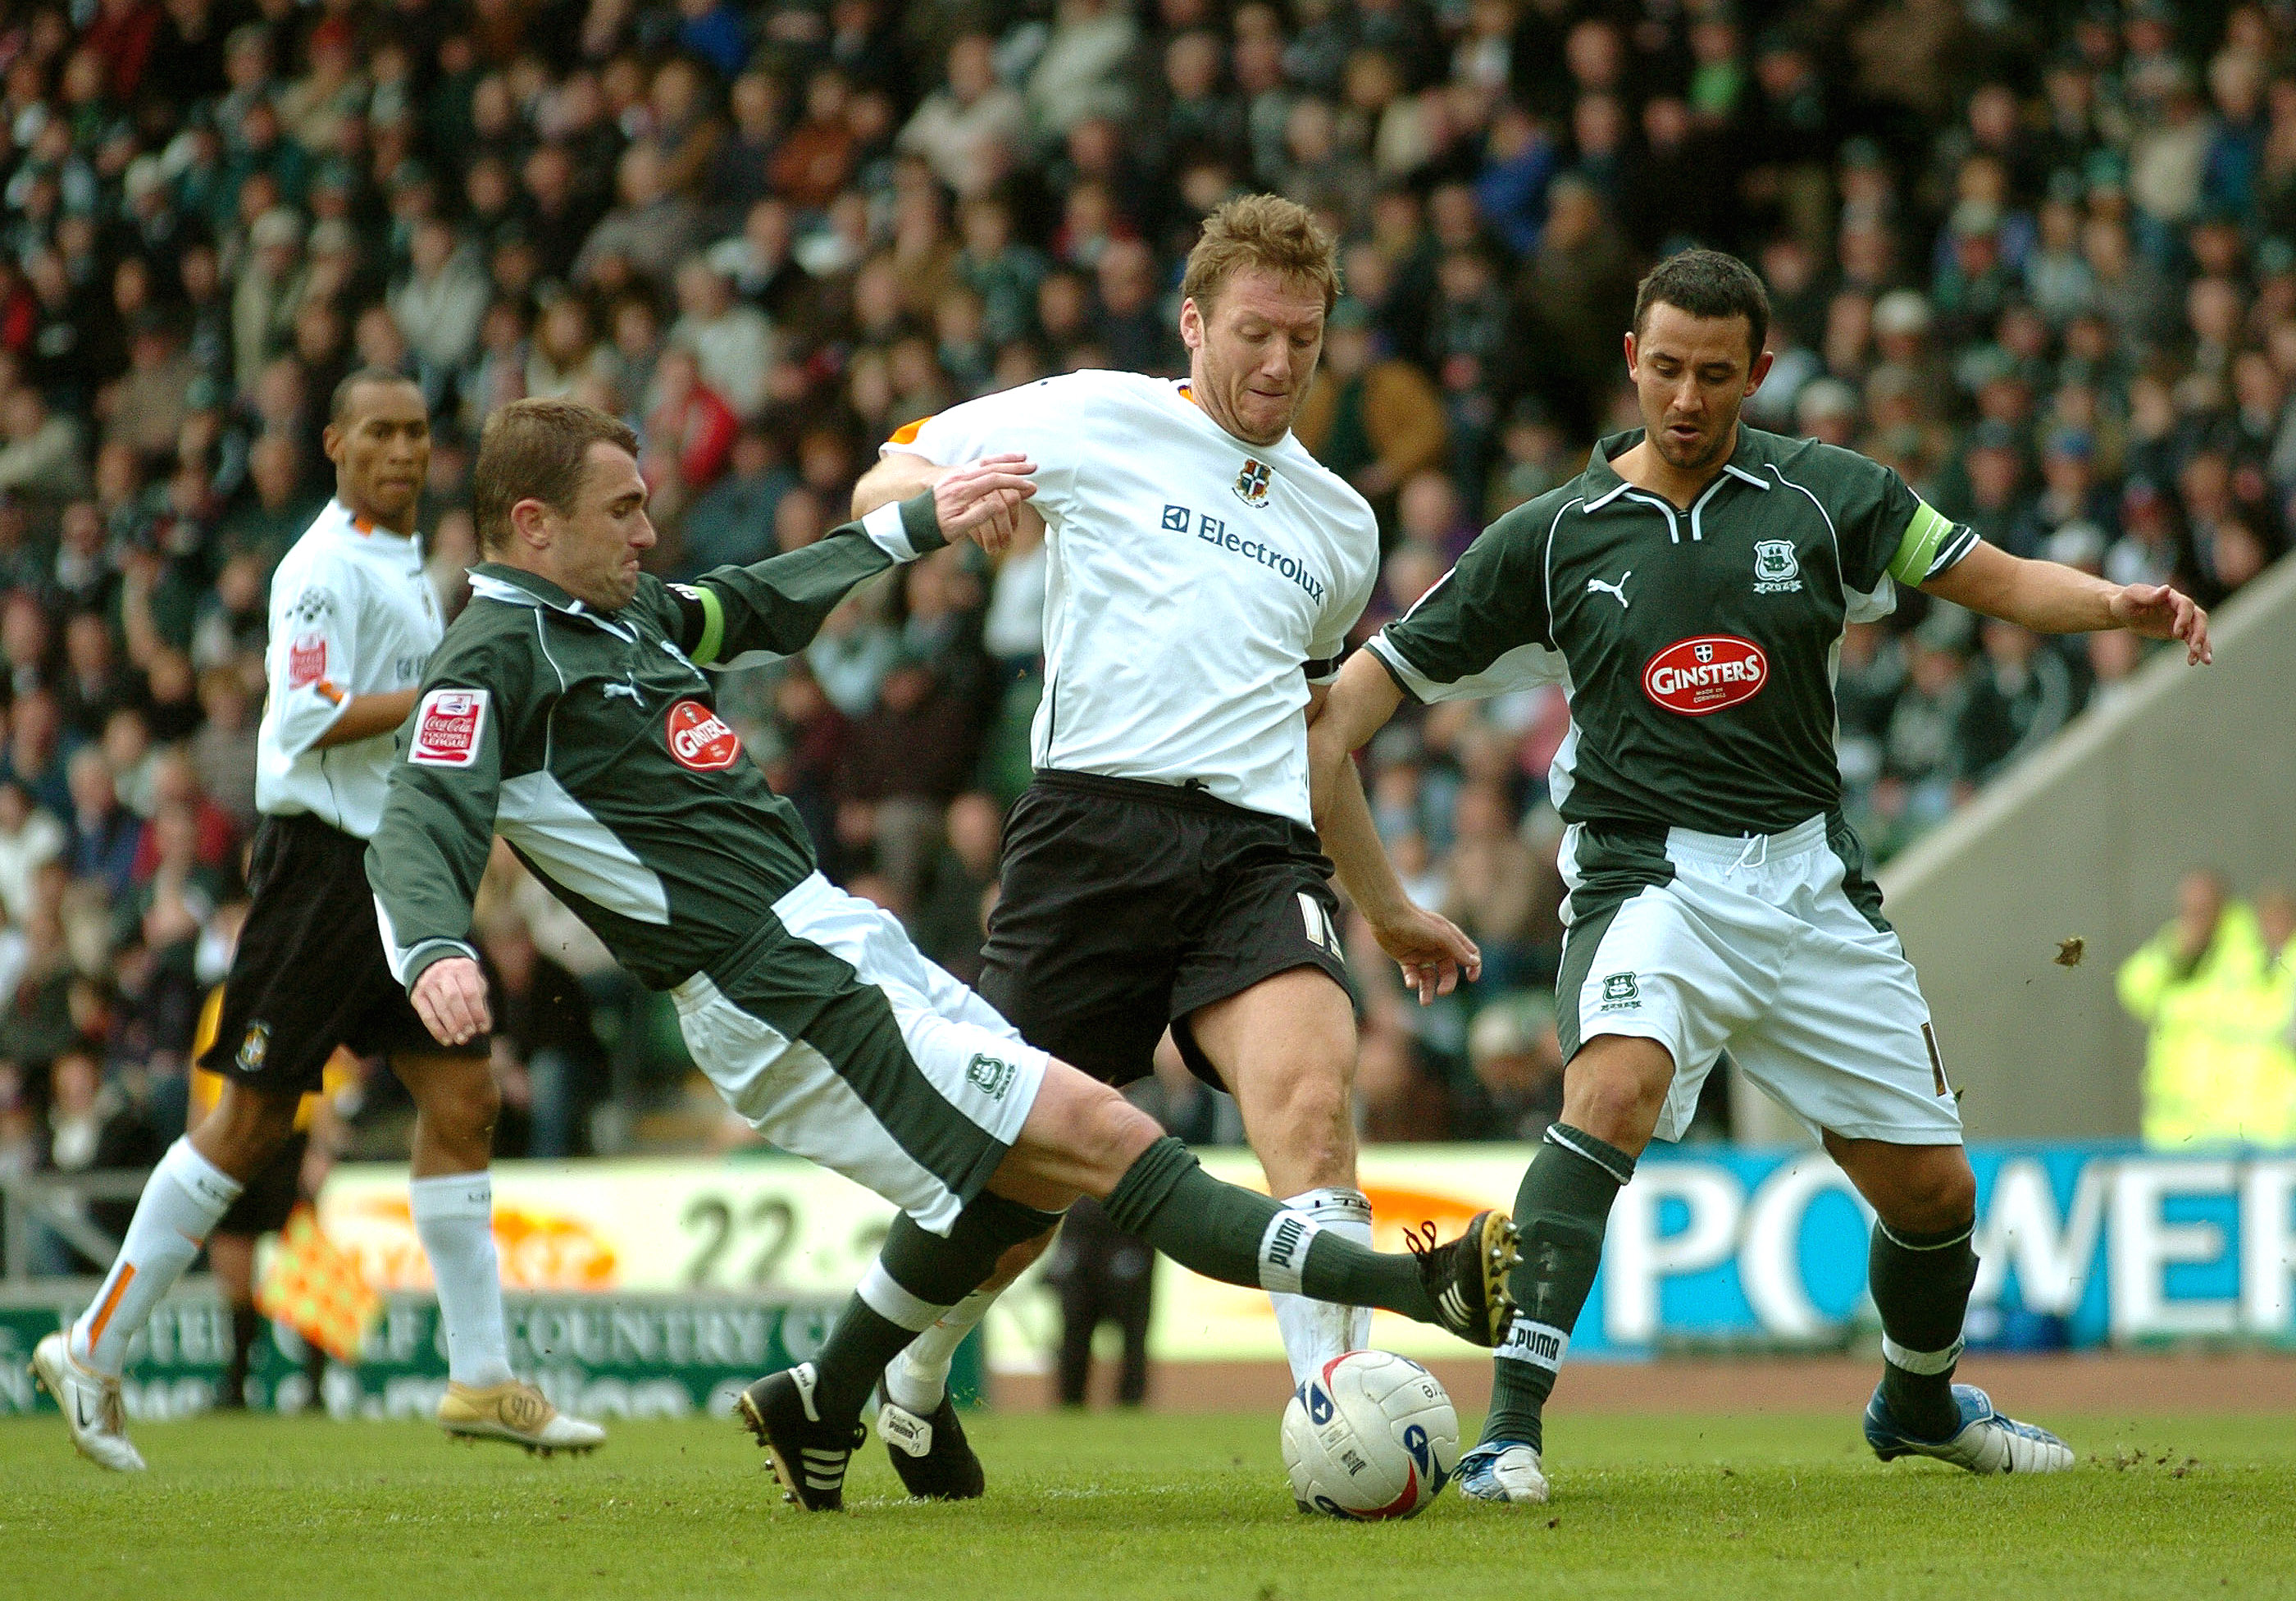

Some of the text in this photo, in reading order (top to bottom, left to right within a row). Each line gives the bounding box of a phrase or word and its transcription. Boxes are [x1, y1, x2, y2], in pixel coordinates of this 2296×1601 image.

[1198, 513, 1324, 606] Electrolux
[1651, 655, 1761, 695] GINSTERS
[1269, 1217, 1307, 1269] PUMA
[1515, 1328, 1560, 1362] PUMA
